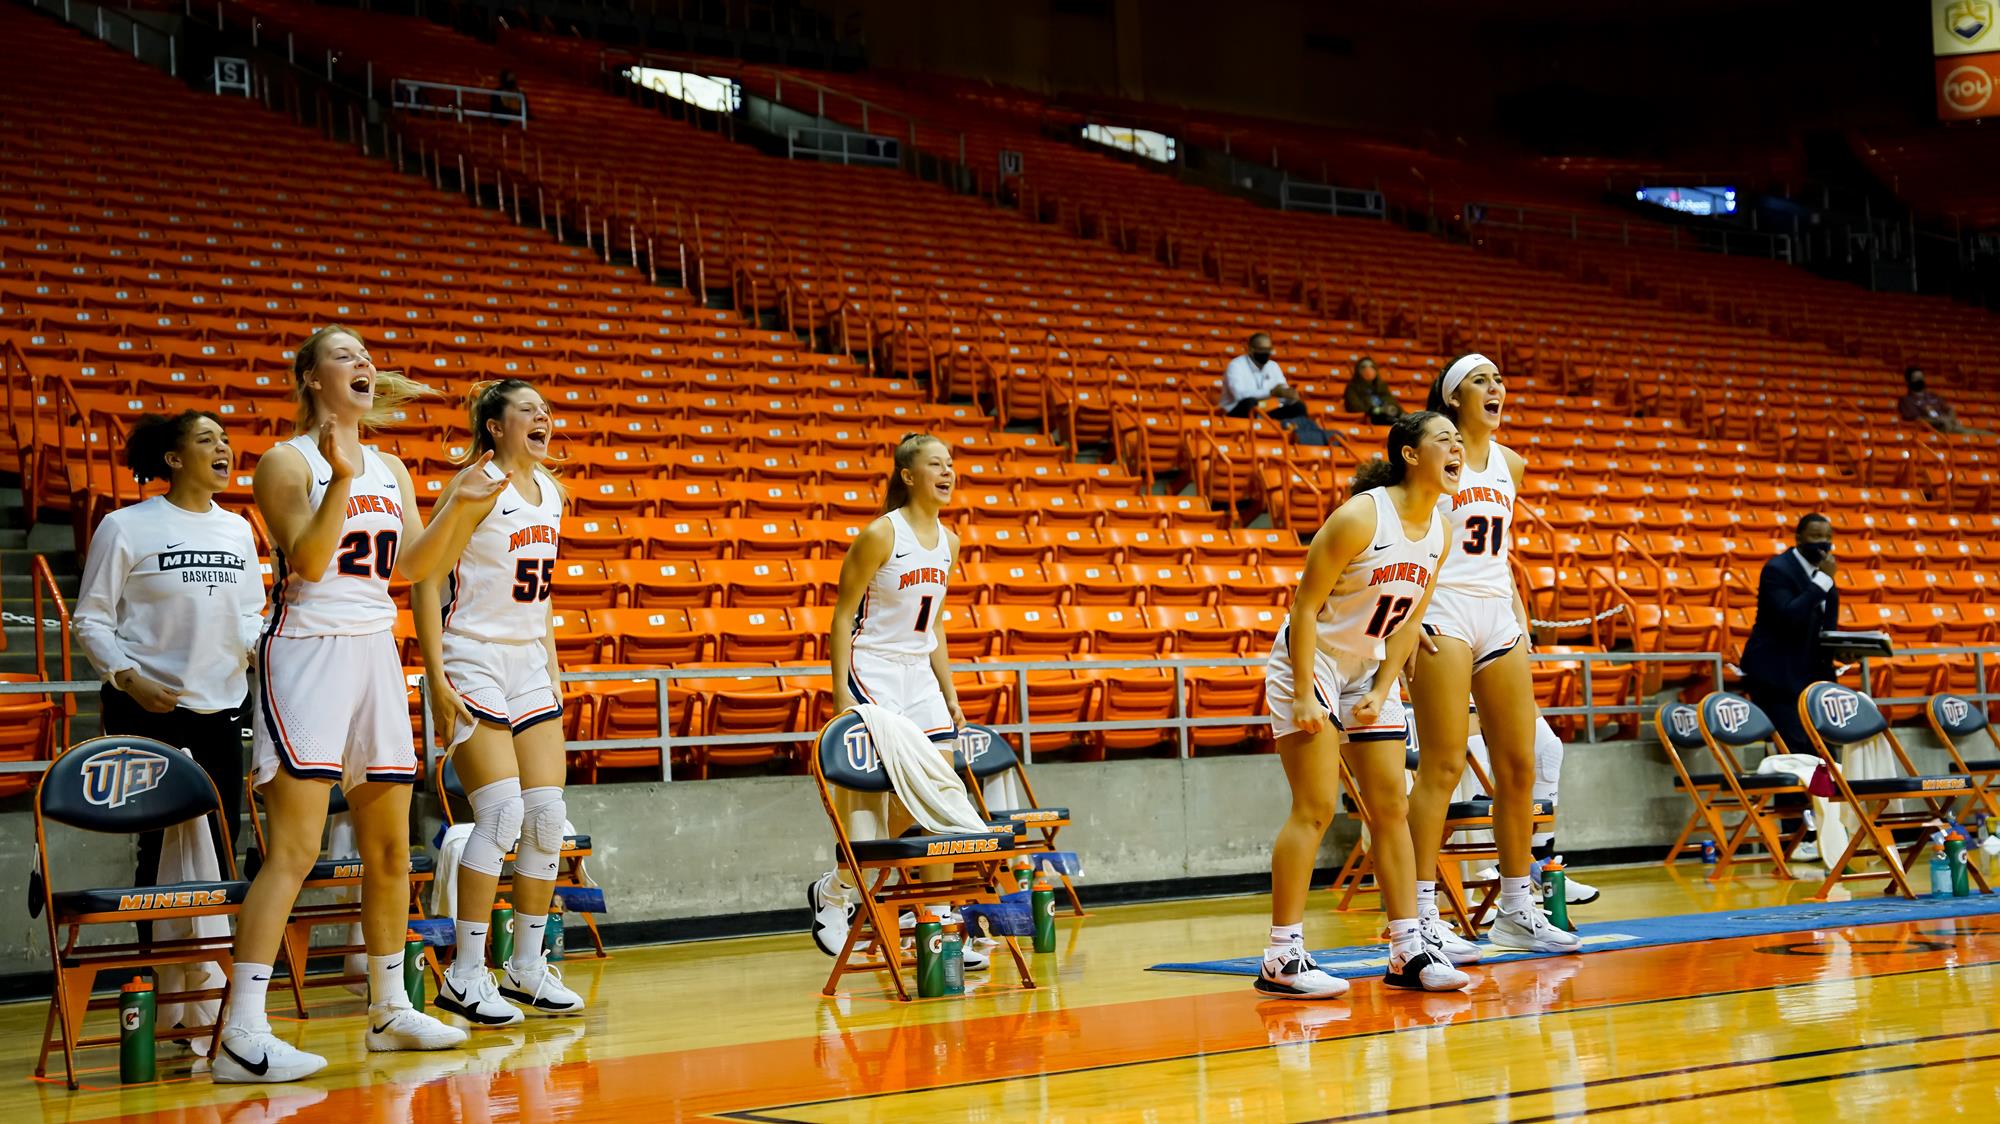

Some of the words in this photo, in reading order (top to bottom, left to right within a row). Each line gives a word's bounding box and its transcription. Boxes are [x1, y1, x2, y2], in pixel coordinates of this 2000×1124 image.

[223, 62, 238, 82] S
[508, 525, 560, 553] MINER
[1462, 515, 1504, 556] 31
[337, 529, 398, 580] 20
[182, 570, 238, 583] BASKETBALL
[512, 557, 557, 603] 55
[898, 567, 949, 590] MINER
[914, 595, 933, 632] 1
[1365, 594, 1413, 639] 12
[1671, 706, 1698, 737] UTE
[1715, 697, 1750, 733] UTEP
[1820, 687, 1859, 729] UTEP
[1942, 696, 1968, 727] UTEP
[843, 723, 881, 773] UT
[81, 747, 169, 809] UTEP
[926, 838, 999, 857] MINERS
[118, 889, 227, 911] MINERS
[122, 1007, 140, 1031] G
